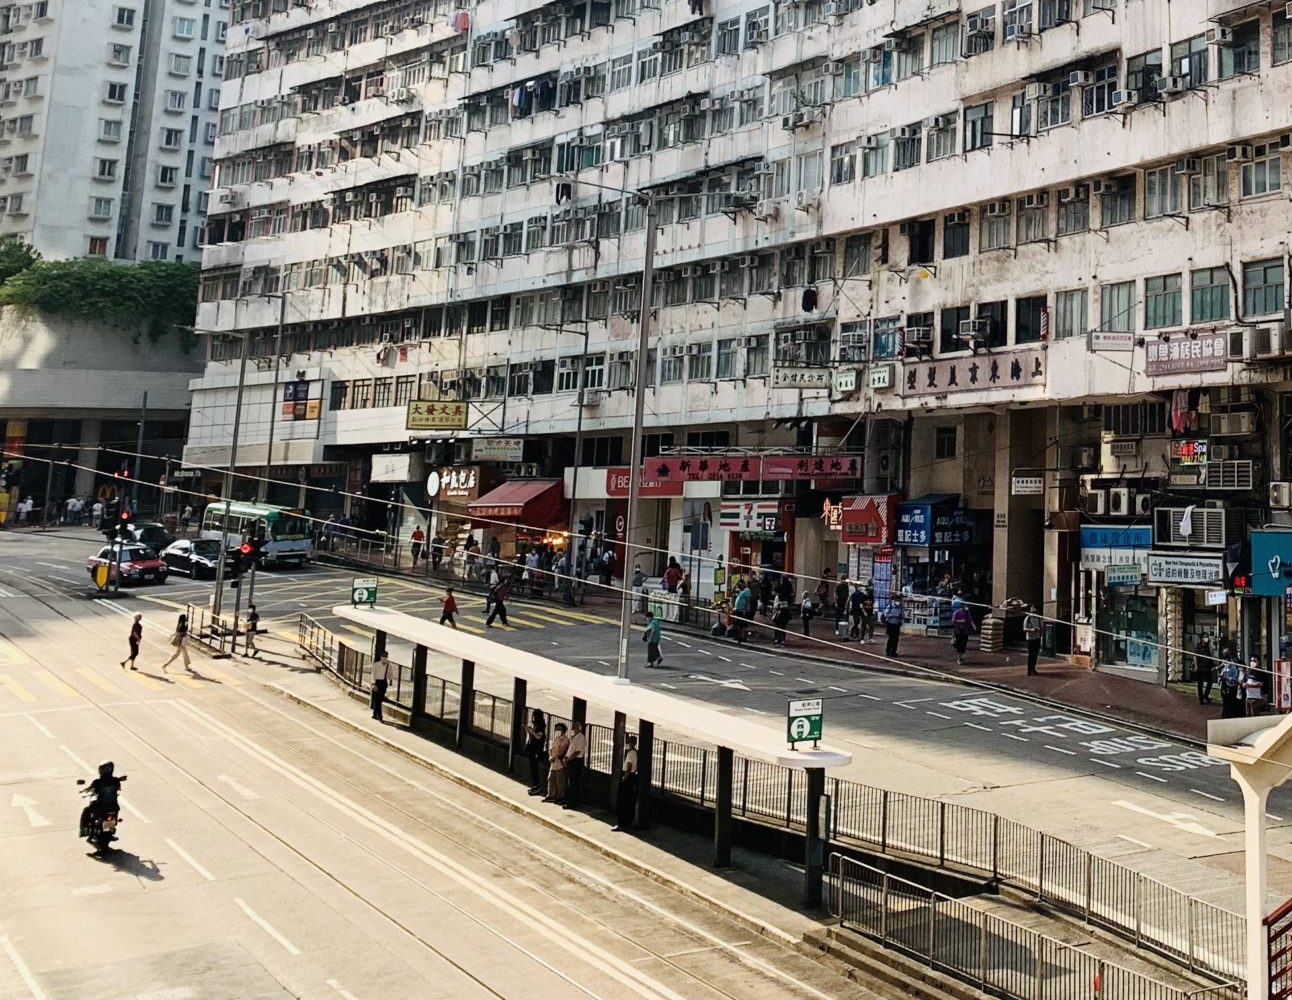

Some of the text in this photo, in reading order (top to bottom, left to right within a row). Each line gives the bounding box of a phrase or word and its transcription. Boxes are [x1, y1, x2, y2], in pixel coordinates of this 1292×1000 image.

[411, 403, 463, 416] 大發文具
[1079, 735, 1172, 754] STOP
[1136, 752, 1231, 771] BUS
